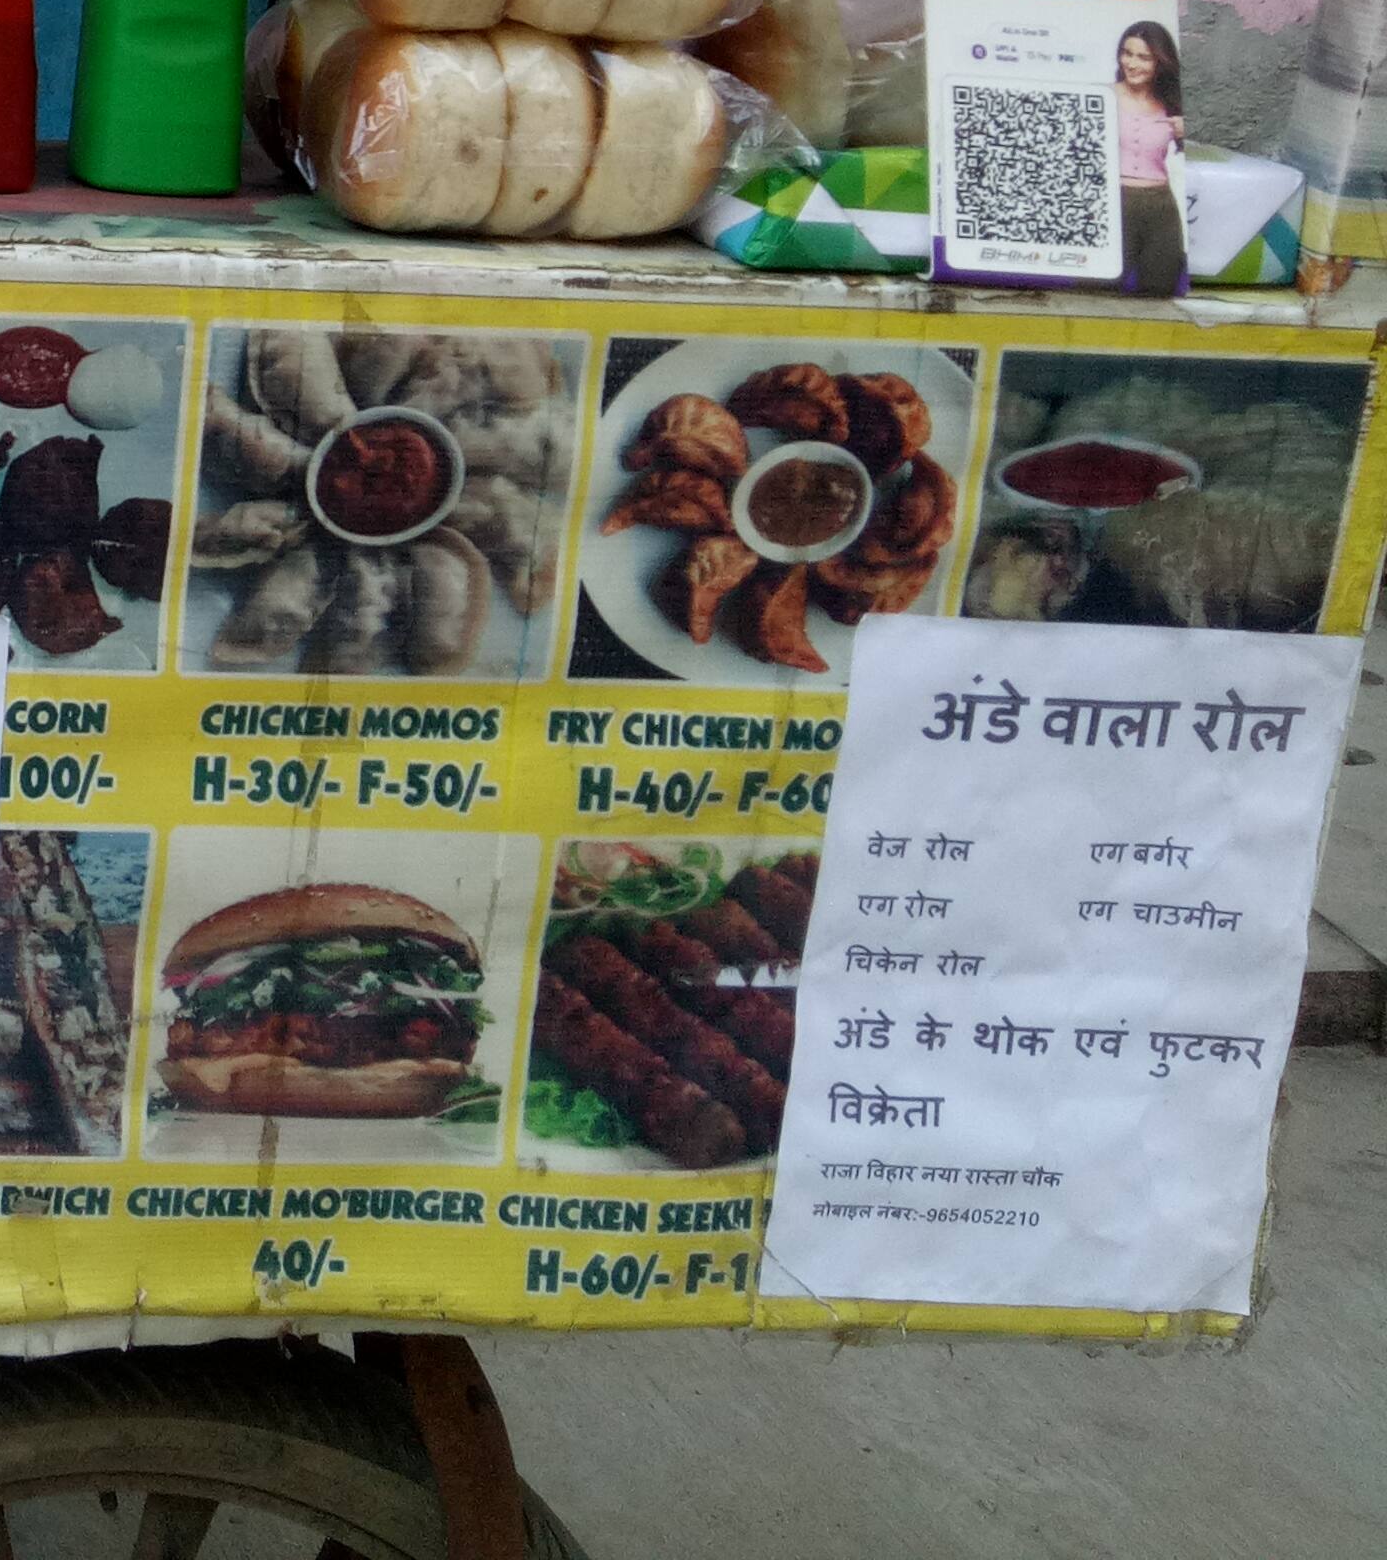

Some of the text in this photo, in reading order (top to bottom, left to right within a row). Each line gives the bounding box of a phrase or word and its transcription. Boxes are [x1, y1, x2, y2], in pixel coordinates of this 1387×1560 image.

[4, 700, 107, 734] CORN
[201, 704, 499, 741] CHICKEN MOMOS
[548, 710, 773, 750] FRY CHICKEN
[921, 674, 1306, 753] अंडे वाला रोल
[193, 756, 497, 813] H-30/- F-50/-
[578, 766, 724, 818] H-40/-
[867, 830, 975, 862] वेज रोल
[1090, 836, 1194, 870] एग बर्गर
[857, 889, 953, 919] एग रोल
[1078, 900, 1243, 932] एग चाउमीन
[936, 949, 986, 977] रोल
[833, 1006, 1265, 1078] अंडे के थोक एवं फुटकर
[827, 1081, 945, 1129] विक्रेता
[126, 1187, 484, 1224] CHICKEN MO'BURGER
[498, 1194, 753, 1234] CHICKEN SEEKH
[253, 1239, 344, 1287] 40/-
[526, 1249, 670, 1300] H-60/-
